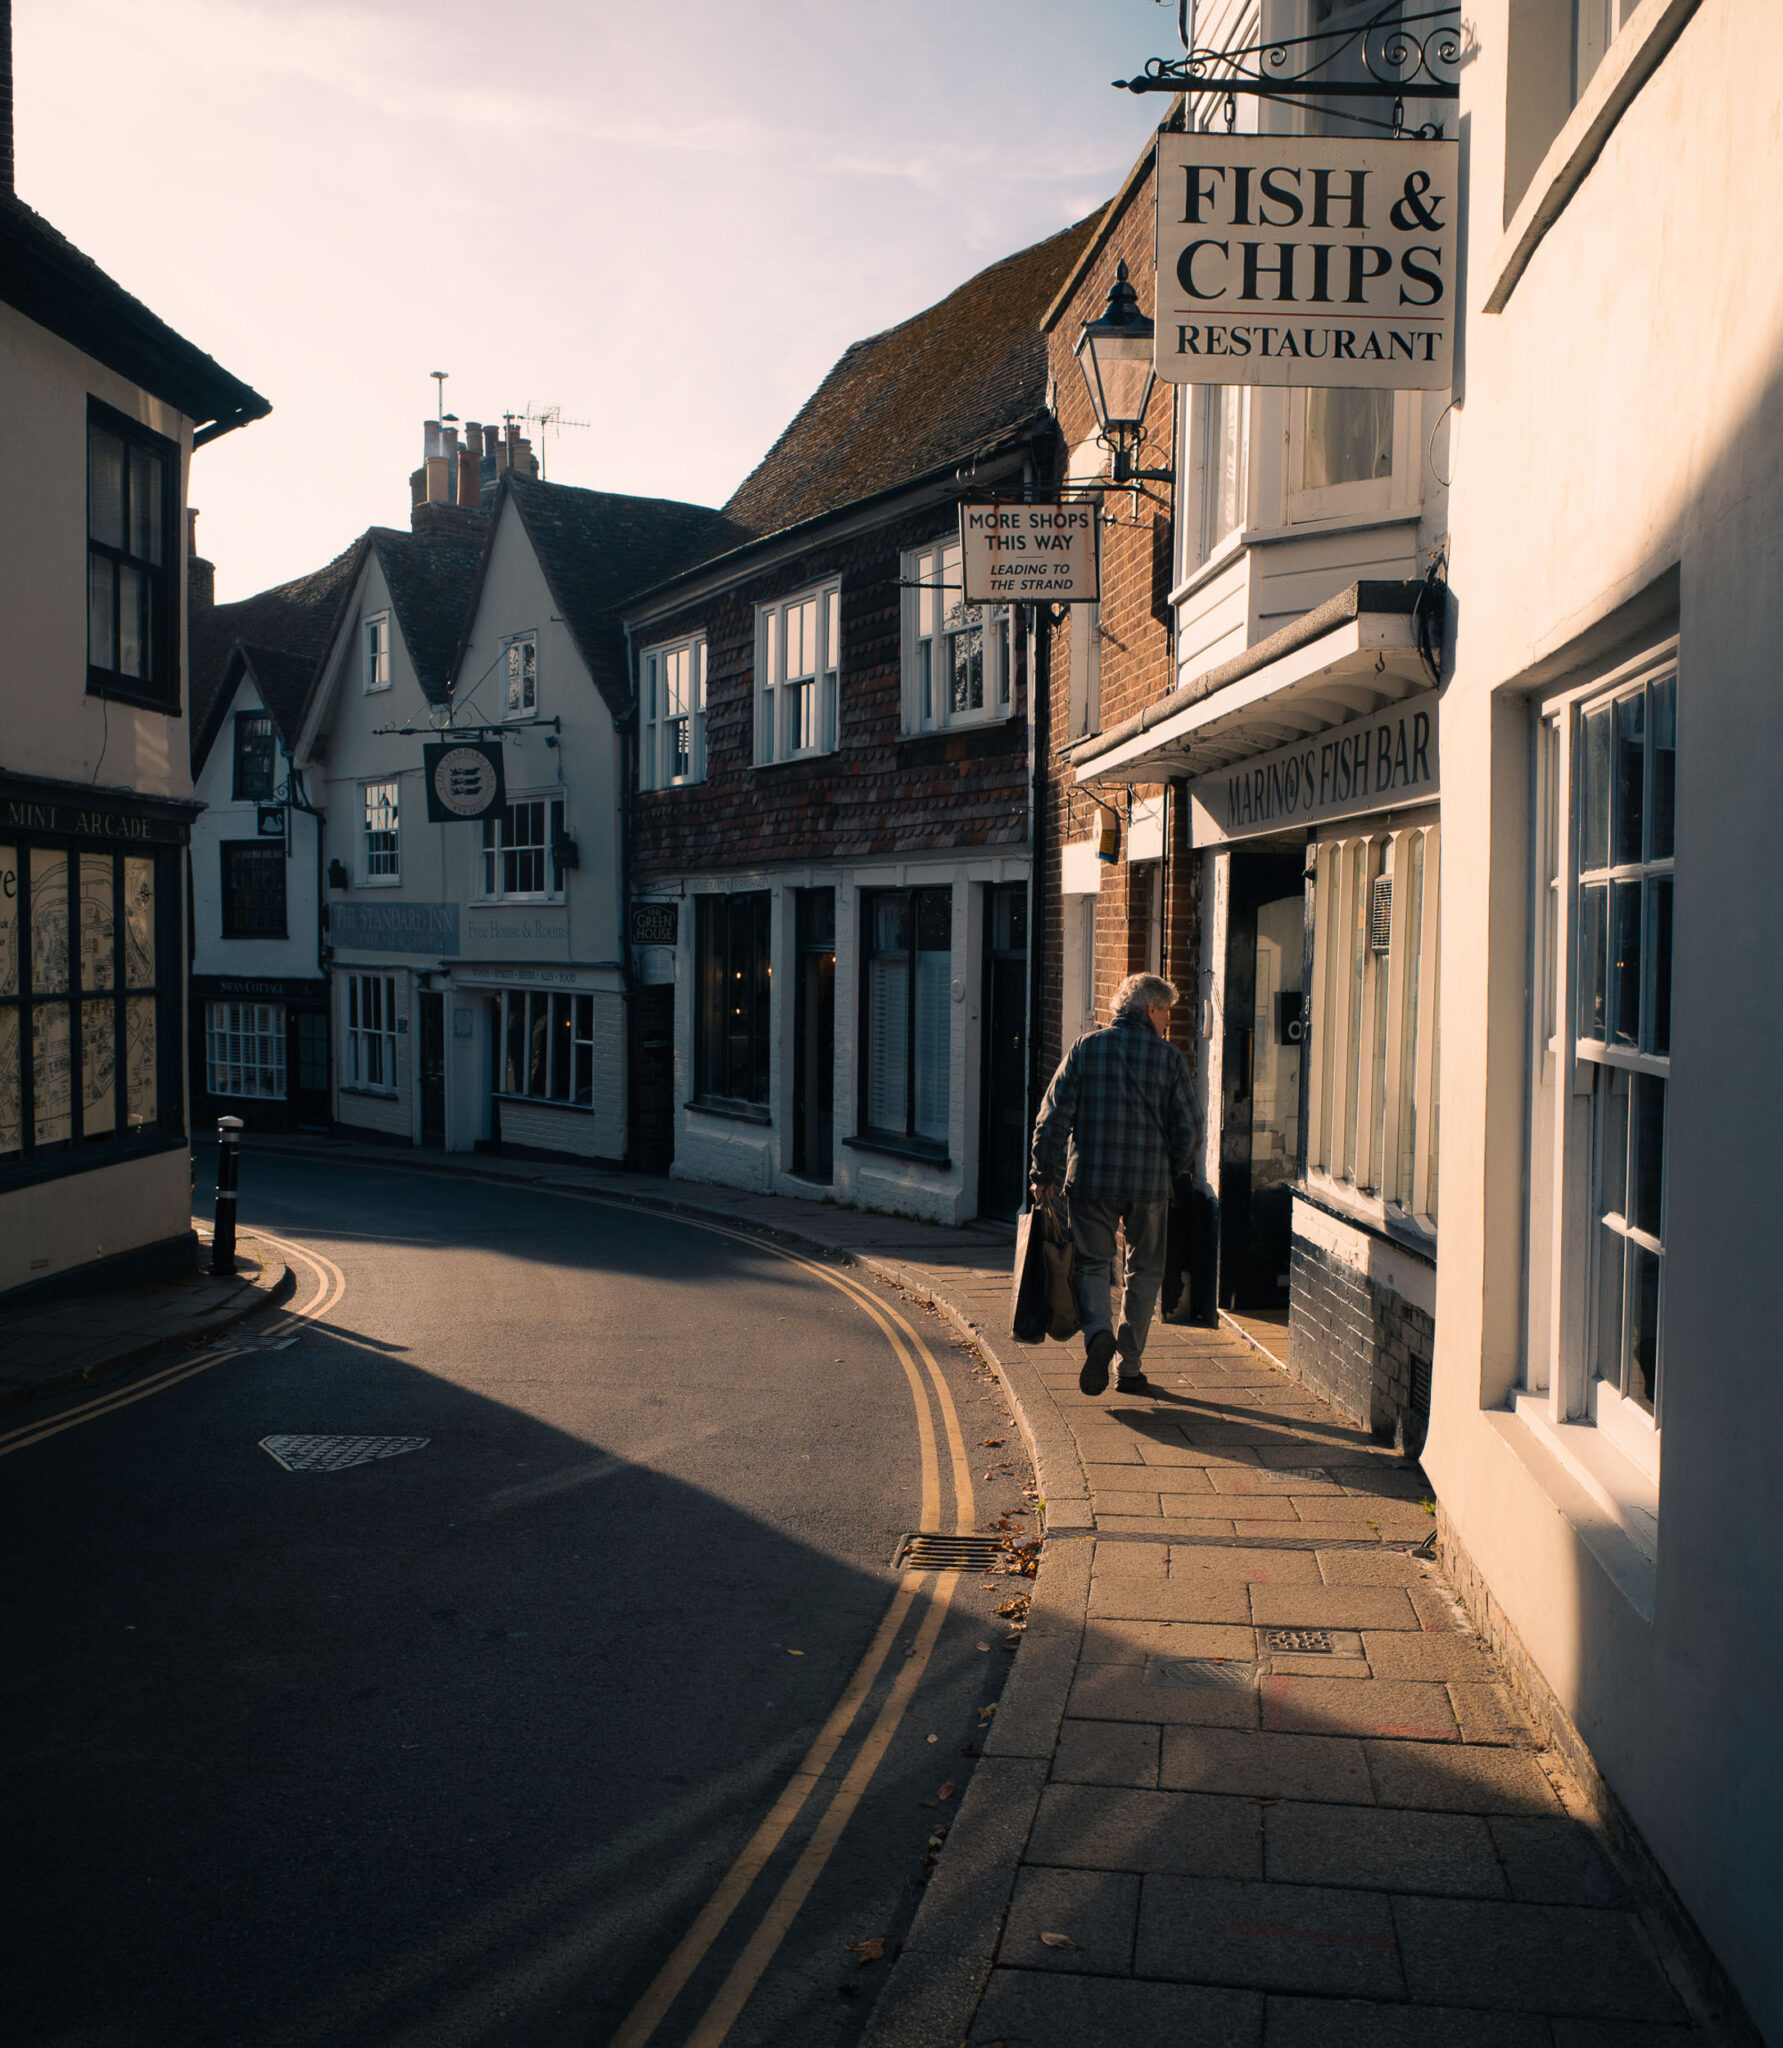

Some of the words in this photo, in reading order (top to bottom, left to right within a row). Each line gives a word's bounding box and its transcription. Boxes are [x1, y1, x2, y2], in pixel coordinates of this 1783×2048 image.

[1177, 164, 1374, 229] FISH
[1389, 170, 1446, 232] &
[1176, 239, 1444, 306] CHIPS
[1175, 324, 1443, 361] RESTAURANT
[969, 513, 1021, 529] MORE
[1029, 513, 1089, 529] SHOPS
[984, 535, 1026, 550] THIS
[1034, 535, 1073, 550] WAY
[990, 564, 1047, 575] LEADING
[1052, 563, 1070, 575] TO
[990, 580, 1015, 591] THE
[1020, 579, 1073, 590] STRAND
[1226, 750, 1316, 828] MARINO'S
[1319, 730, 1372, 807] FISH
[1374, 711, 1431, 794] BAR
[7, 800, 56, 829] MINT
[75, 810, 152, 839] ARCADE
[335, 905, 356, 928] THE
[360, 904, 426, 930] STANDARD
[427, 906, 453, 931] INN
[636, 914, 673, 928] GREEN
[468, 920, 487, 938] Free
[489, 920, 520, 938] House
[522, 921, 533, 938] &
[534, 920, 568, 939] Rooms
[636, 927, 673, 940] HOUSE
[541, 971, 554, 981] ALES
[559, 972, 576, 983] FOOD
[220, 980, 245, 993] SWAN
[246, 982, 285, 994] COTTAGE
